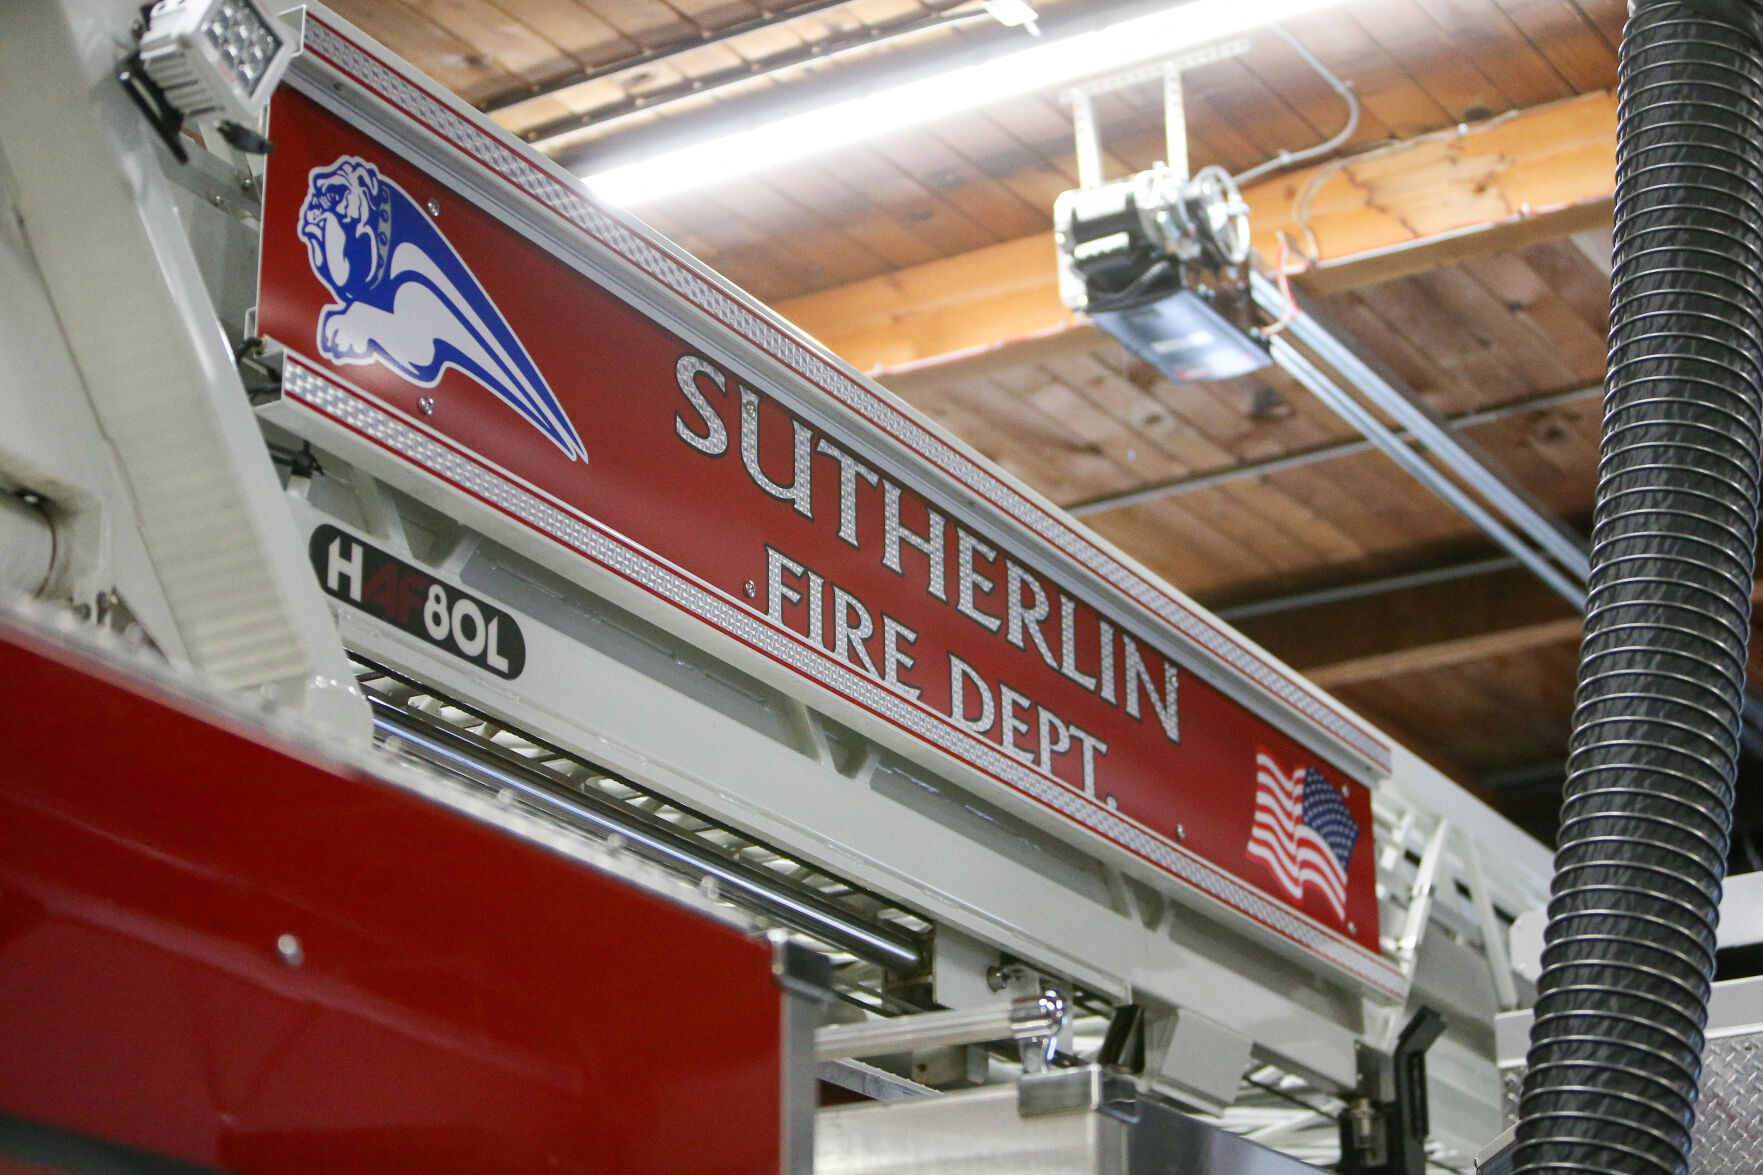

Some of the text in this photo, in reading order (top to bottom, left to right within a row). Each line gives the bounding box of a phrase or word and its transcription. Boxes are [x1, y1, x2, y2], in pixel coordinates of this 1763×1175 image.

[674, 354, 1182, 745] SUTHERLIN
[765, 543, 1119, 810] FIRE DEPT.
